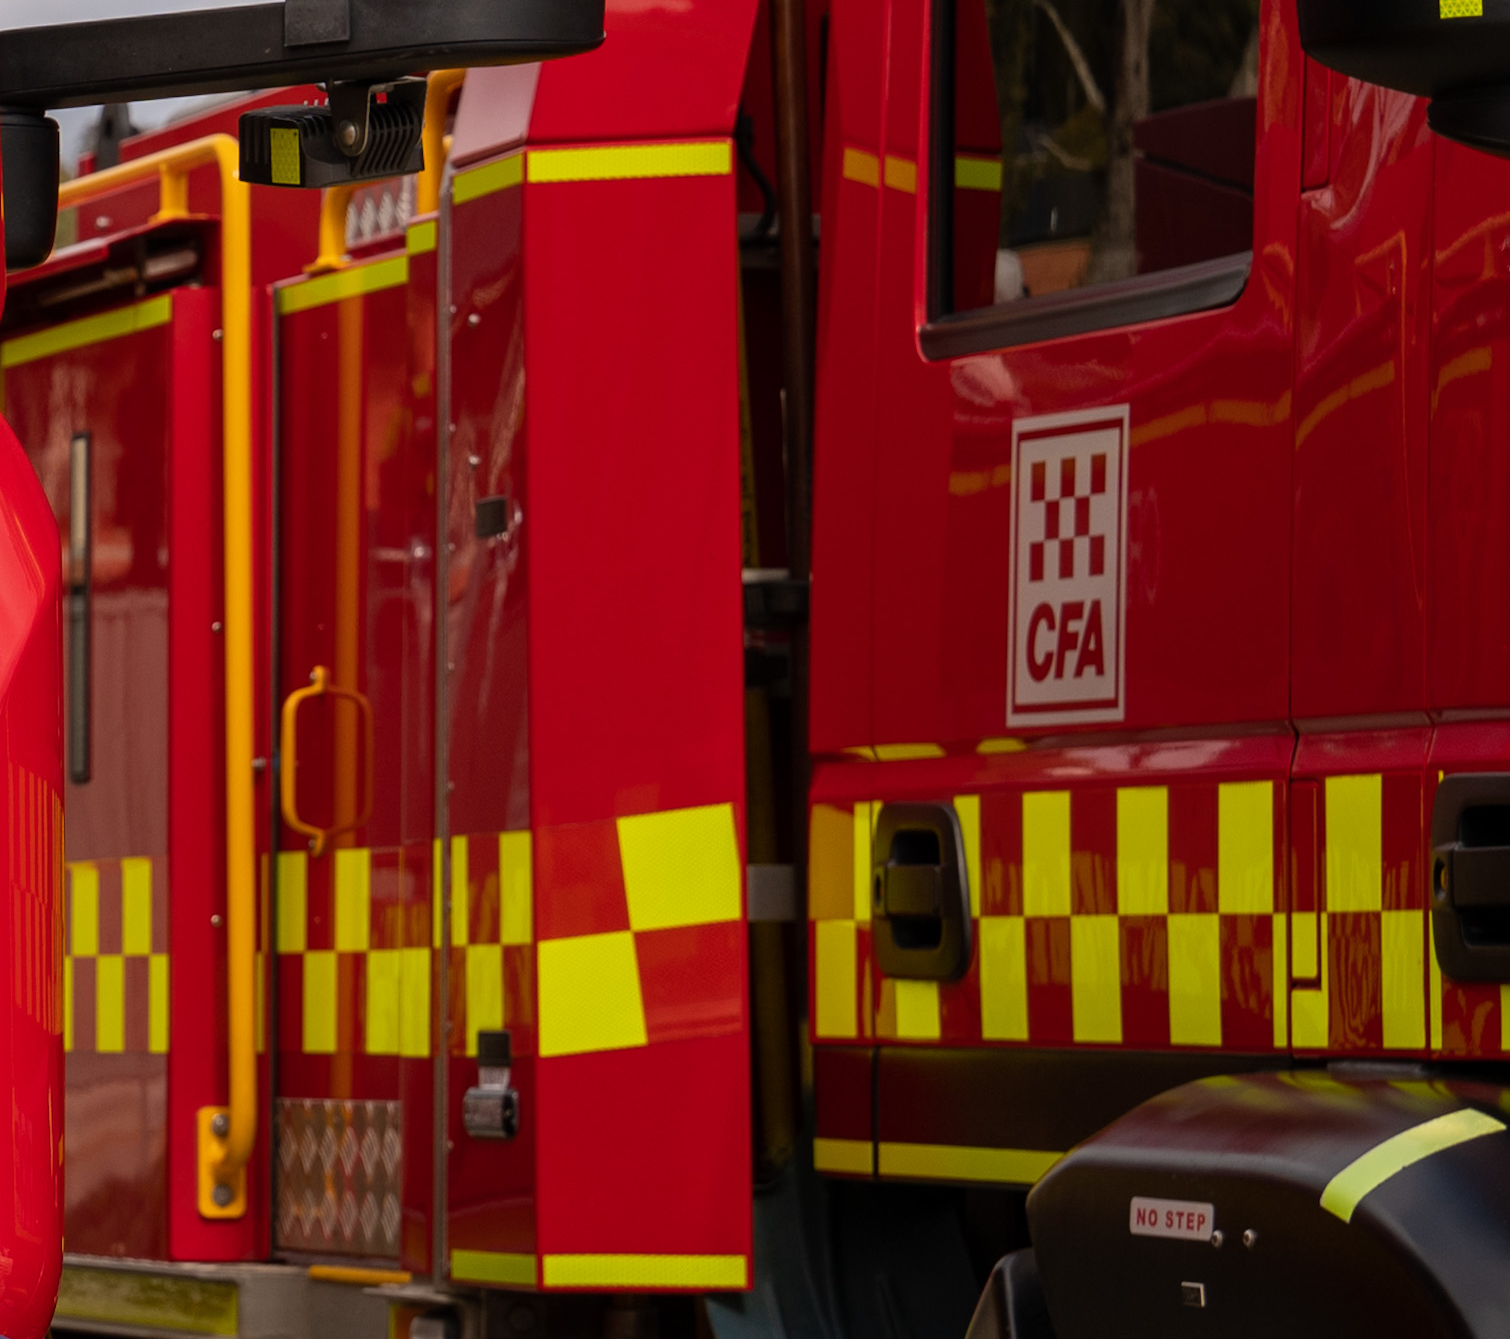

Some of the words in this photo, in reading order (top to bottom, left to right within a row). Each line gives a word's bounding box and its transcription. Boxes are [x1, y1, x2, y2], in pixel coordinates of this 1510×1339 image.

[1026, 599, 1105, 683] CFA
[1136, 1207, 1158, 1227] NO
[1165, 1209, 1206, 1231] STEP
